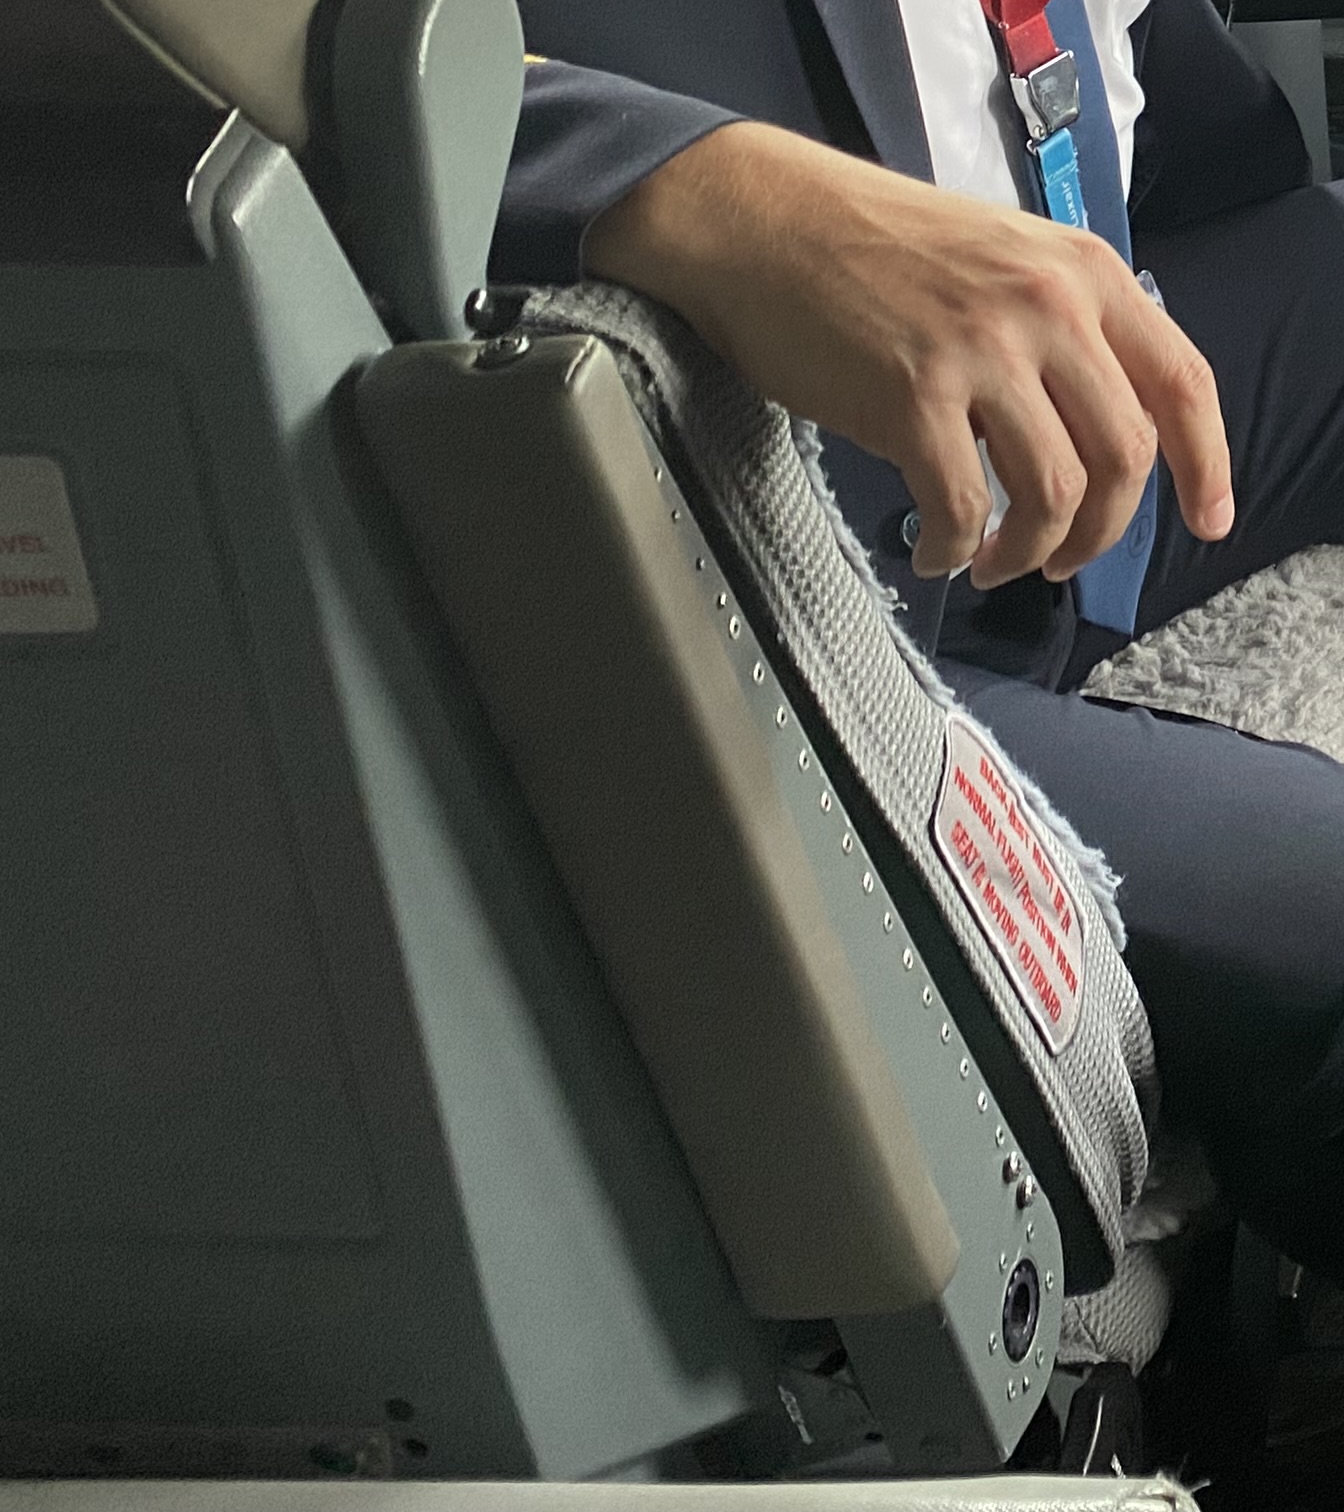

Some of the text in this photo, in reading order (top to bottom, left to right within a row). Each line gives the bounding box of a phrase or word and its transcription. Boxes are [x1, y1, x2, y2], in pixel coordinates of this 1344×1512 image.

[952, 821, 979, 869] SEAT
[983, 878, 1019, 947] MOVING
[1018, 941, 1061, 1023] OUTBOARD
[955, 766, 996, 843] NORMAL
[1016, 880, 1056, 951] POSITION
